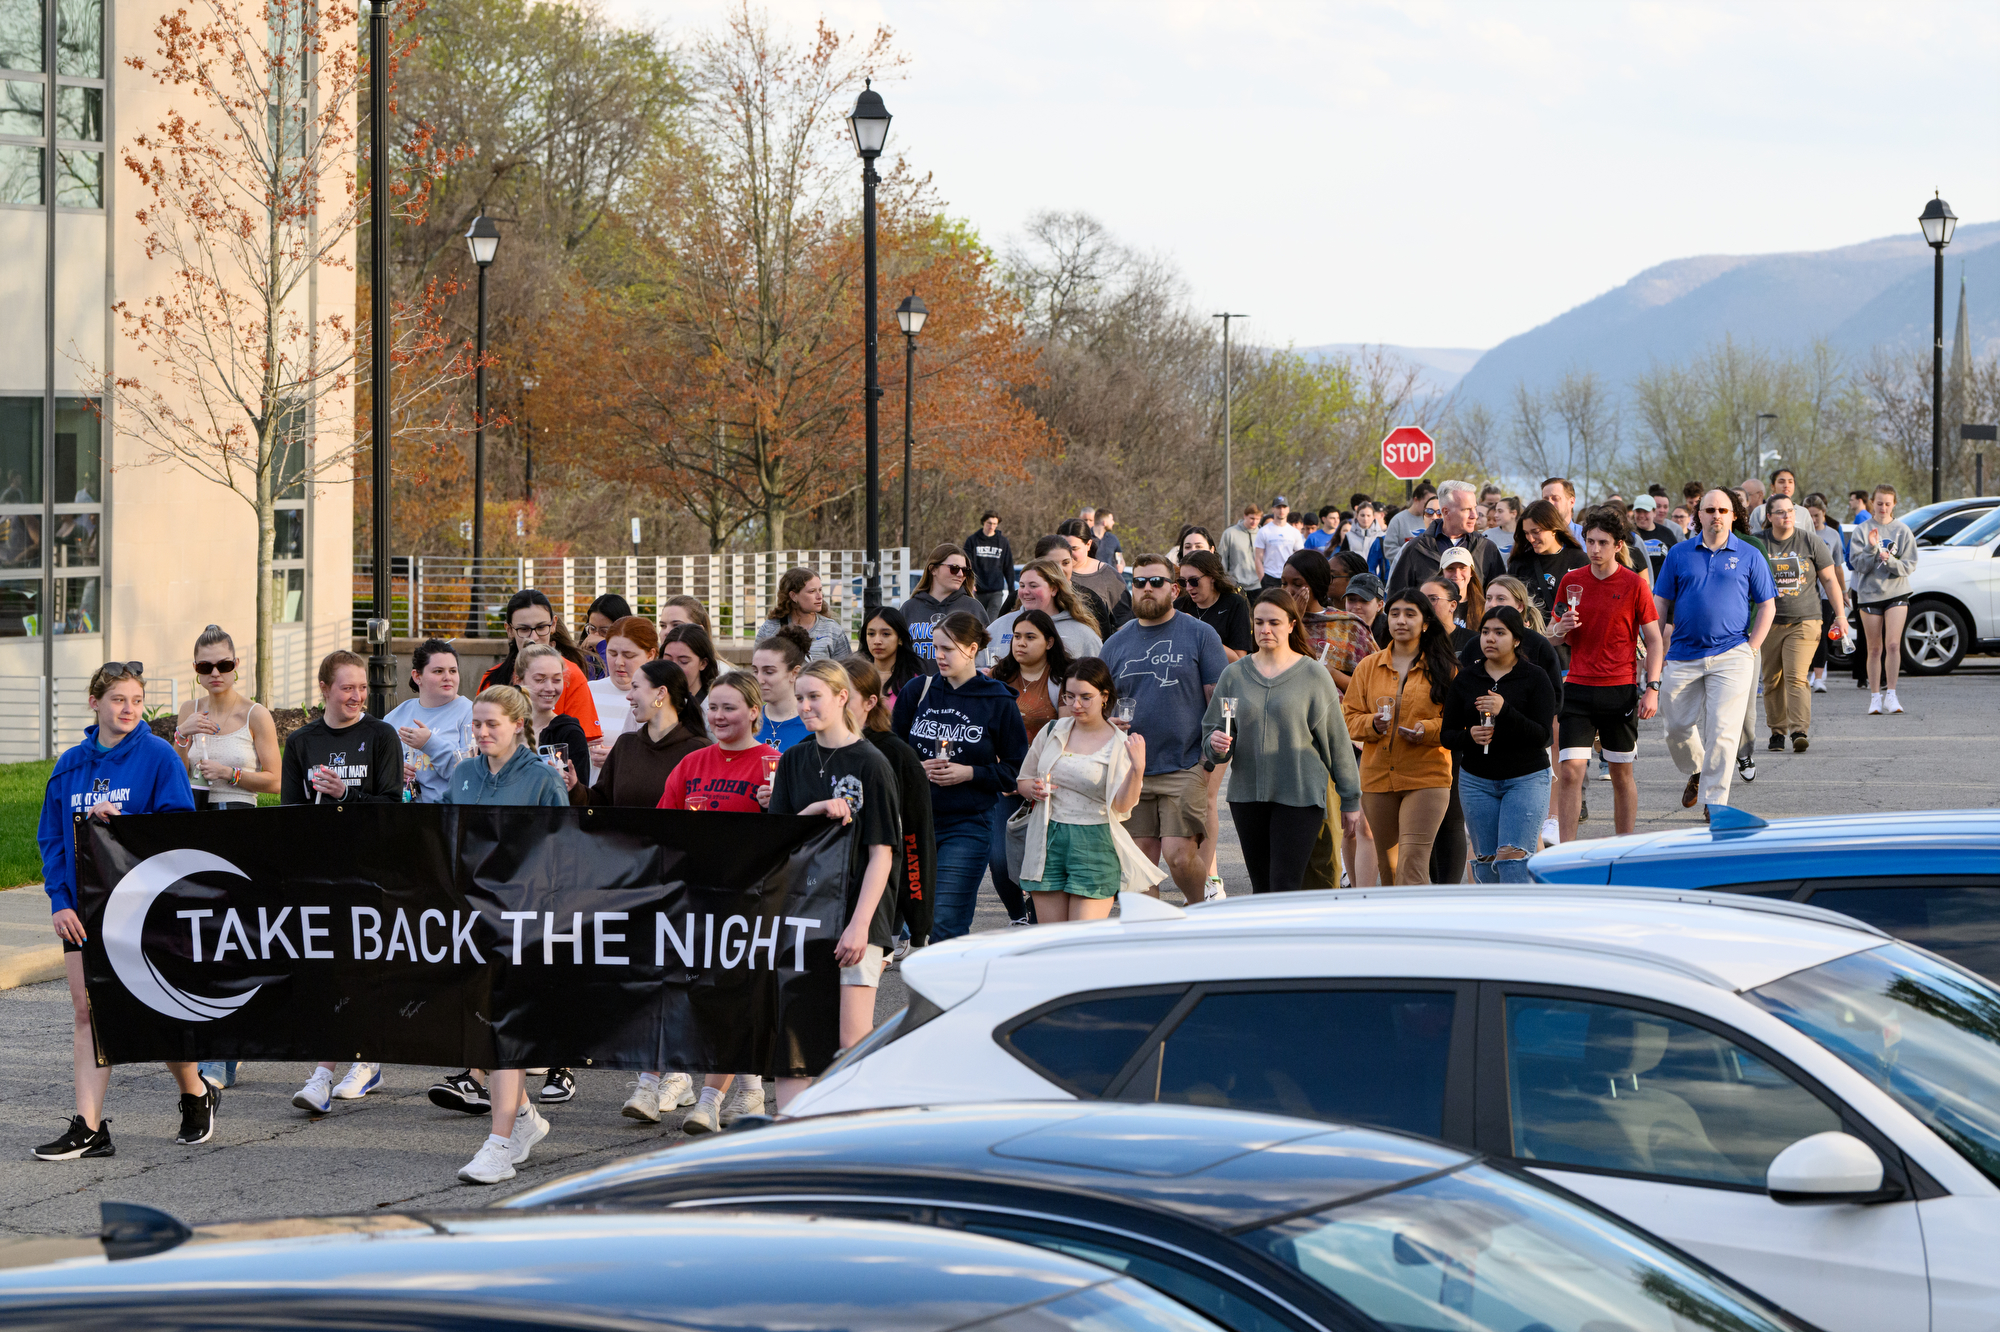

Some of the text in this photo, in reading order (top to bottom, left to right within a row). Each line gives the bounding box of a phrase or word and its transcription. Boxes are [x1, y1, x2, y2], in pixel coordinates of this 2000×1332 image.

[1386, 443, 1431, 463] STOP
[908, 622, 934, 640] KNIG
[913, 642, 936, 660] OFT
[1151, 653, 1184, 665] GOLF
[955, 711, 969, 721] MRY
[910, 719, 983, 743] MSMC
[917, 742, 963, 757] COLGE
[348, 765, 368, 777] MARY
[110, 788, 130, 802] MARY
[686, 778, 760, 802] ST. JOHN'S
[904, 833, 923, 900] PLAYBOY
[176, 906, 822, 973] TAKE BACK THE NIGHT
